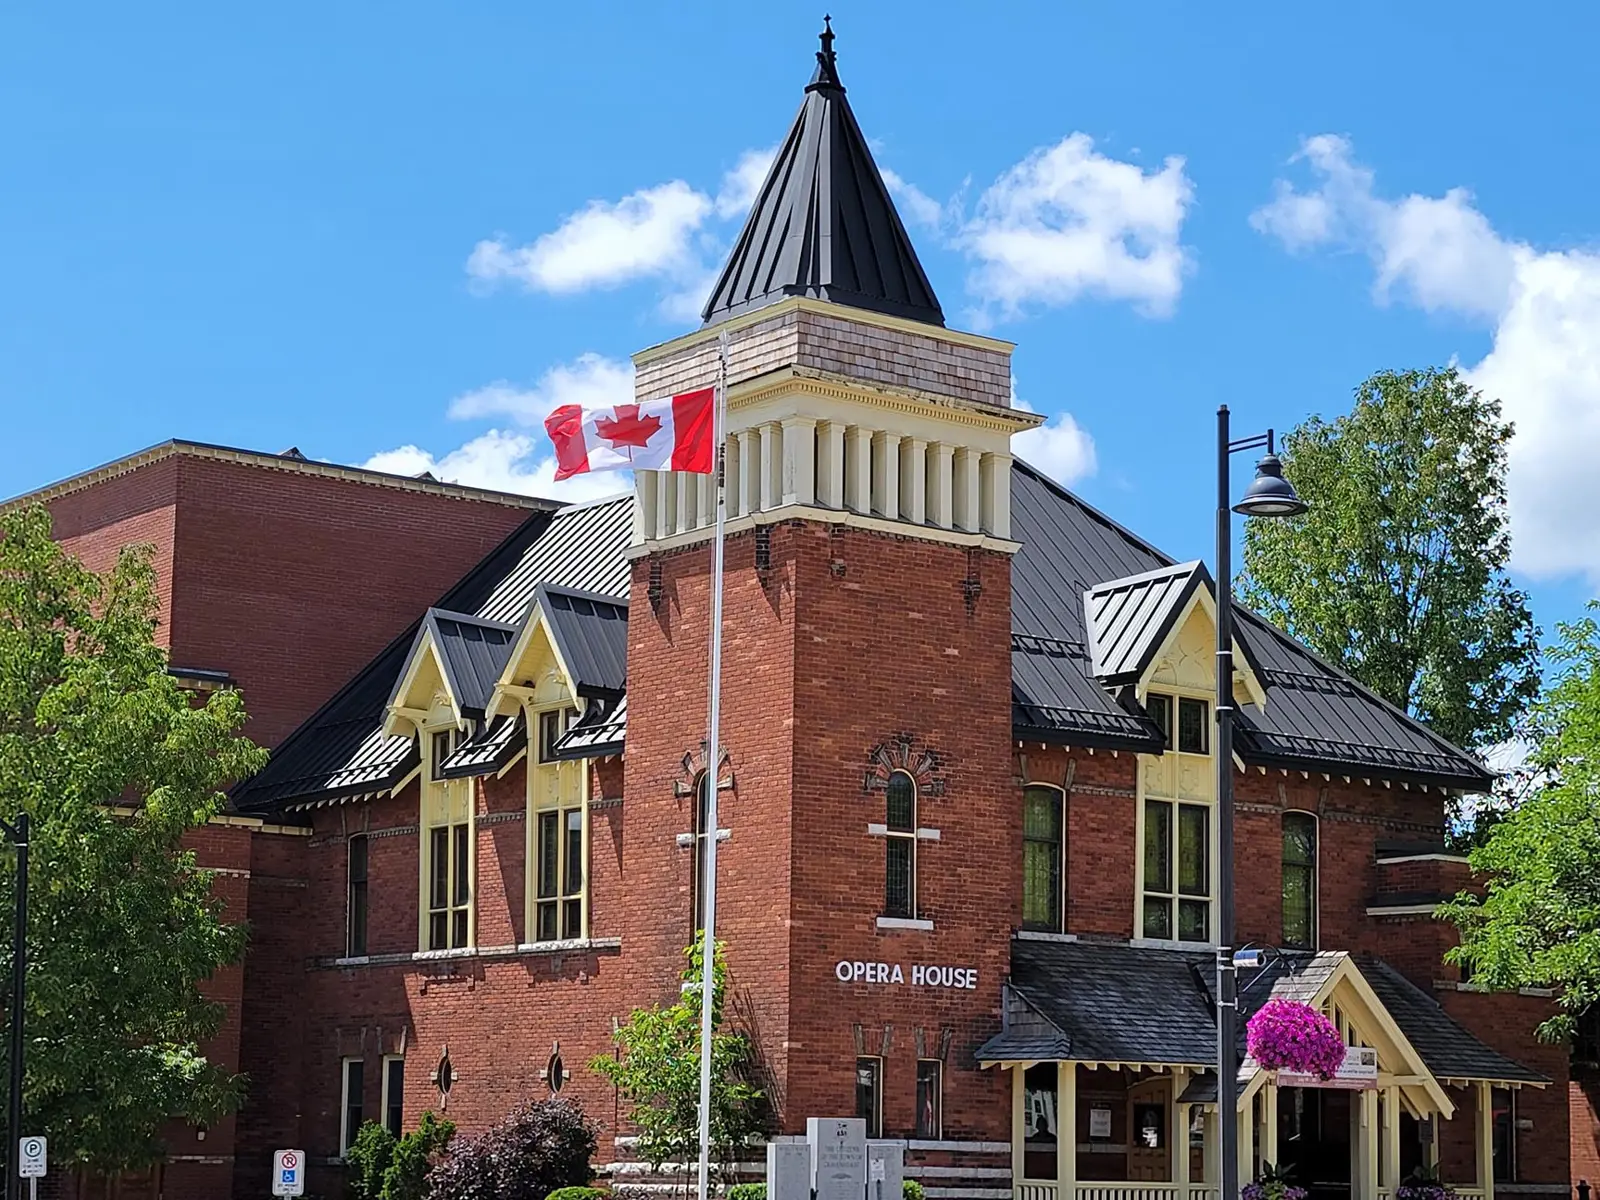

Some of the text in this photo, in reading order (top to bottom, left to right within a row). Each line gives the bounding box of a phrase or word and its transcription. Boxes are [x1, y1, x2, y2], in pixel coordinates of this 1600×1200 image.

[835, 960, 978, 989] OPERA HOUSE
[29, 1143, 38, 1153] P
